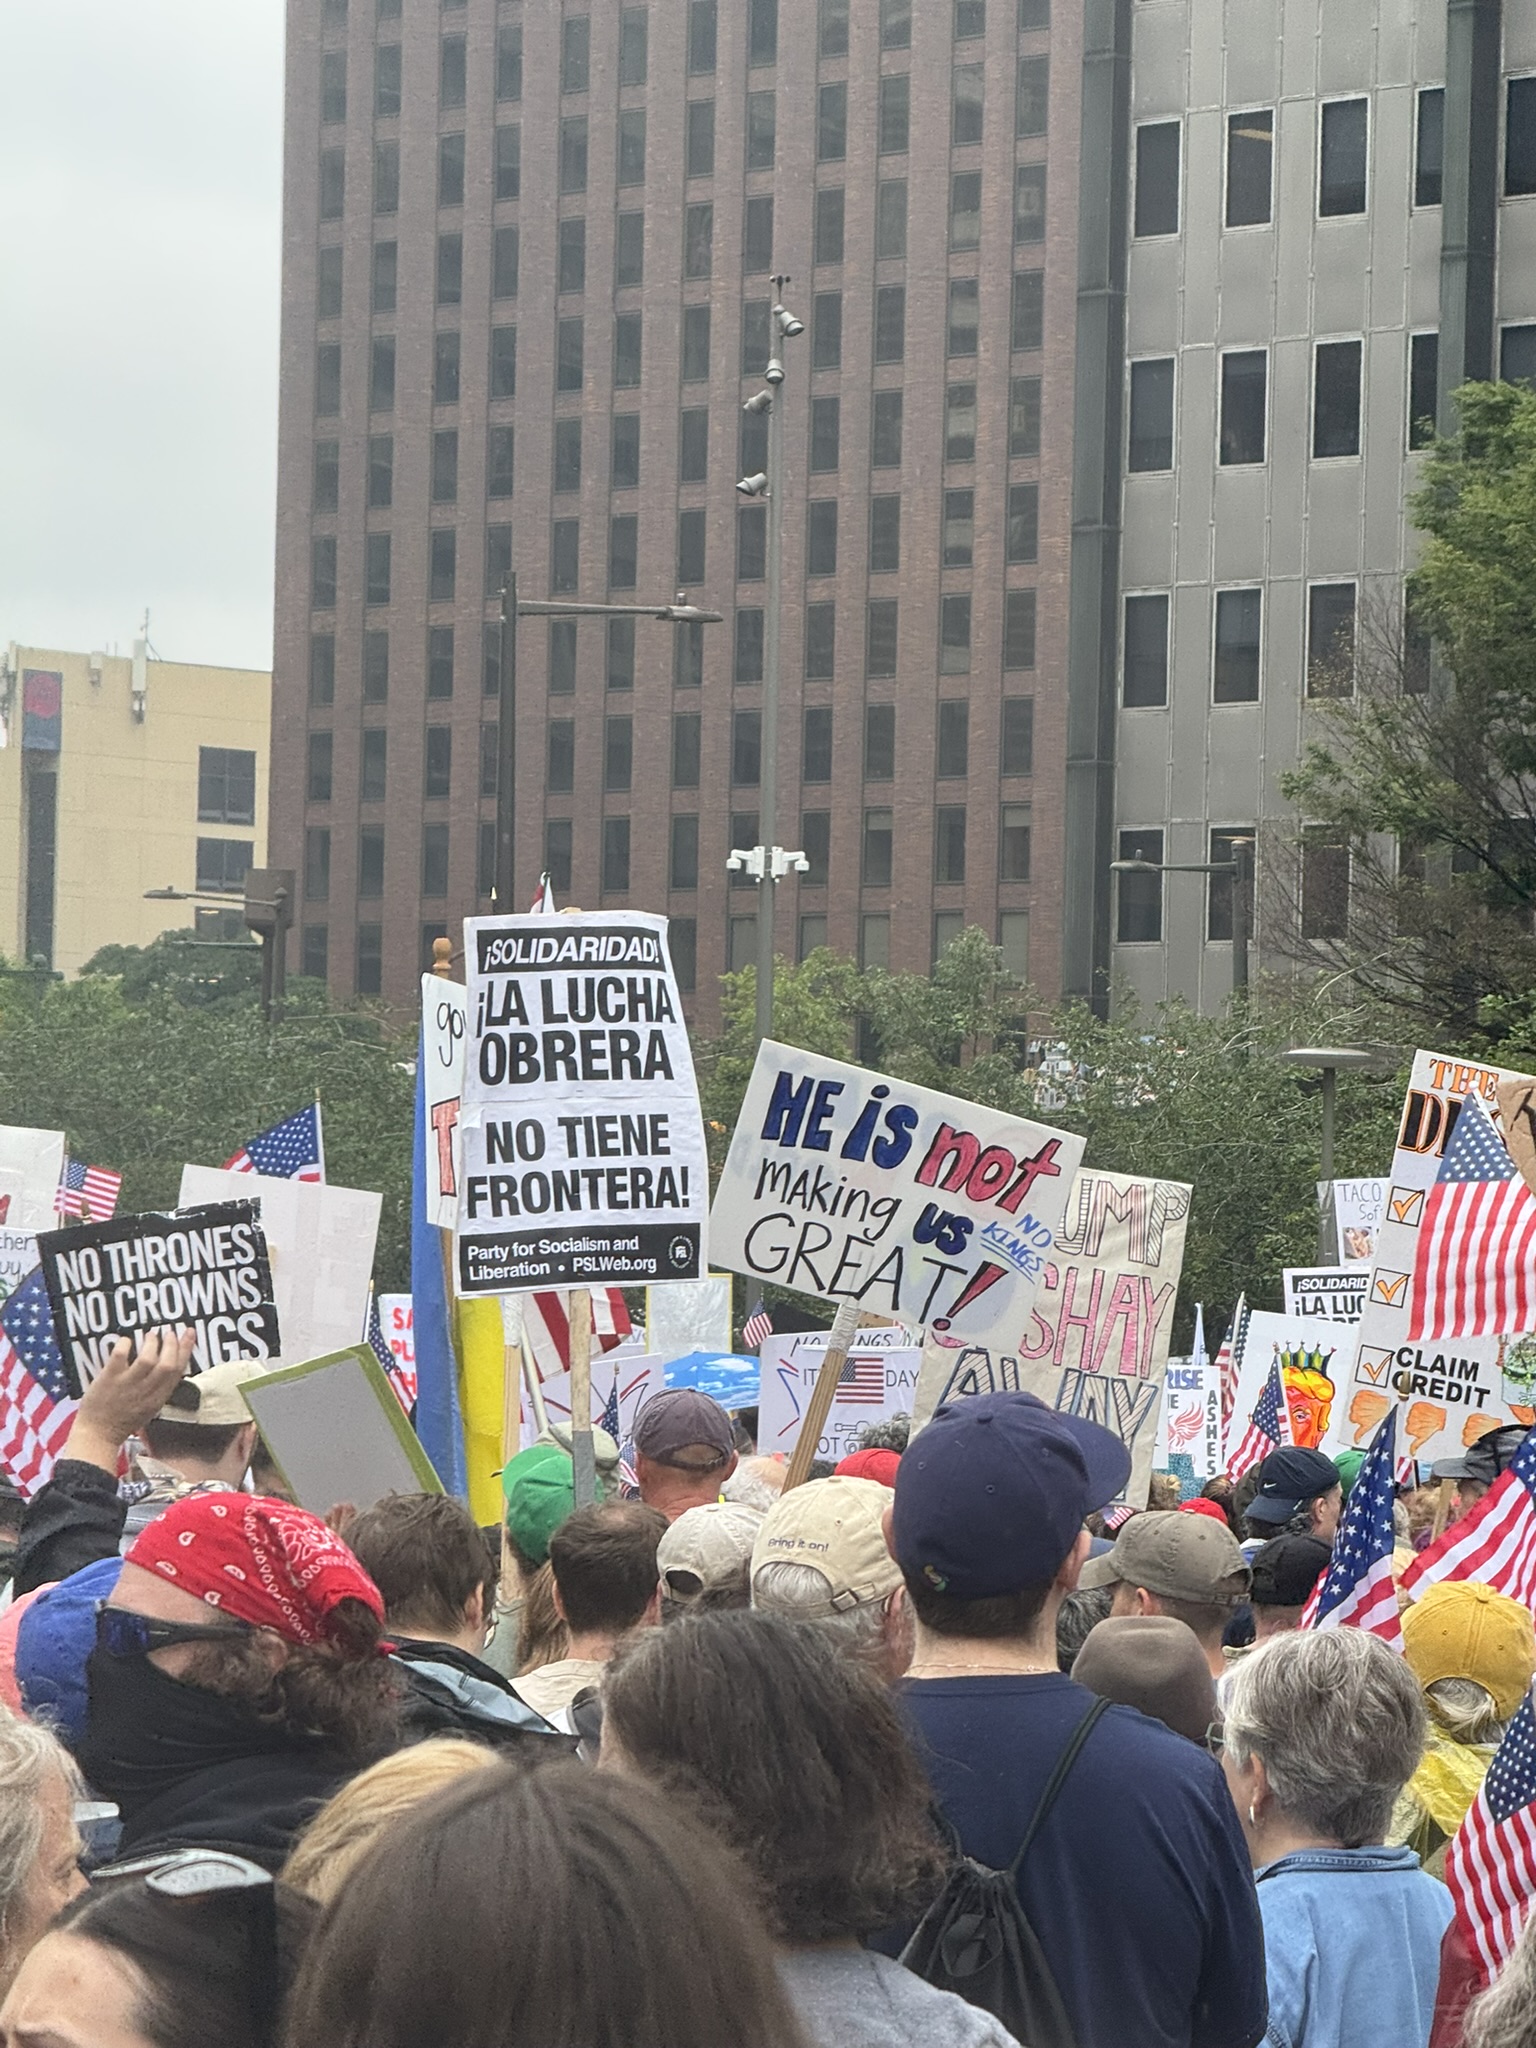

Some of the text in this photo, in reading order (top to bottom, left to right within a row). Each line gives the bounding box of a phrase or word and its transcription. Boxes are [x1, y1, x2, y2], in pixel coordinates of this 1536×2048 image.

[484, 936, 660, 971] ¡SOLIDARIDAD!
[476, 976, 677, 1038] ¡LA LUCHA
[437, 1003, 467, 1067] go
[479, 1029, 675, 1086] OBRERA
[1429, 1059, 1499, 1101] THE
[486, 1113, 671, 1164] NO TIENE
[761, 1071, 1063, 1214] HE is not
[467, 1166, 690, 1219] FRONTERA!
[1359, 1204, 1383, 1221] Sof
[468, 1236, 639, 1262] Party for Socialism and
[981, 1221, 1045, 1272] KINGS
[1015, 1213, 1052, 1248] NO
[55, 1247, 102, 1293] NO
[103, 1223, 256, 1283] THRONES
[468, 1256, 657, 1281] Liberation PSLWeb.org
[745, 1213, 1010, 1331] GREAT!
[64, 1267, 261, 1337] NO CROWNS
[1295, 1295, 1326, 1316] ¡LA
[886, 1370, 919, 1387] DAY
[1396, 1347, 1479, 1382] CLAIM
[1206, 1390, 1218, 1475] ASHES
[768, 1538, 829, 1552] Bring it on!
